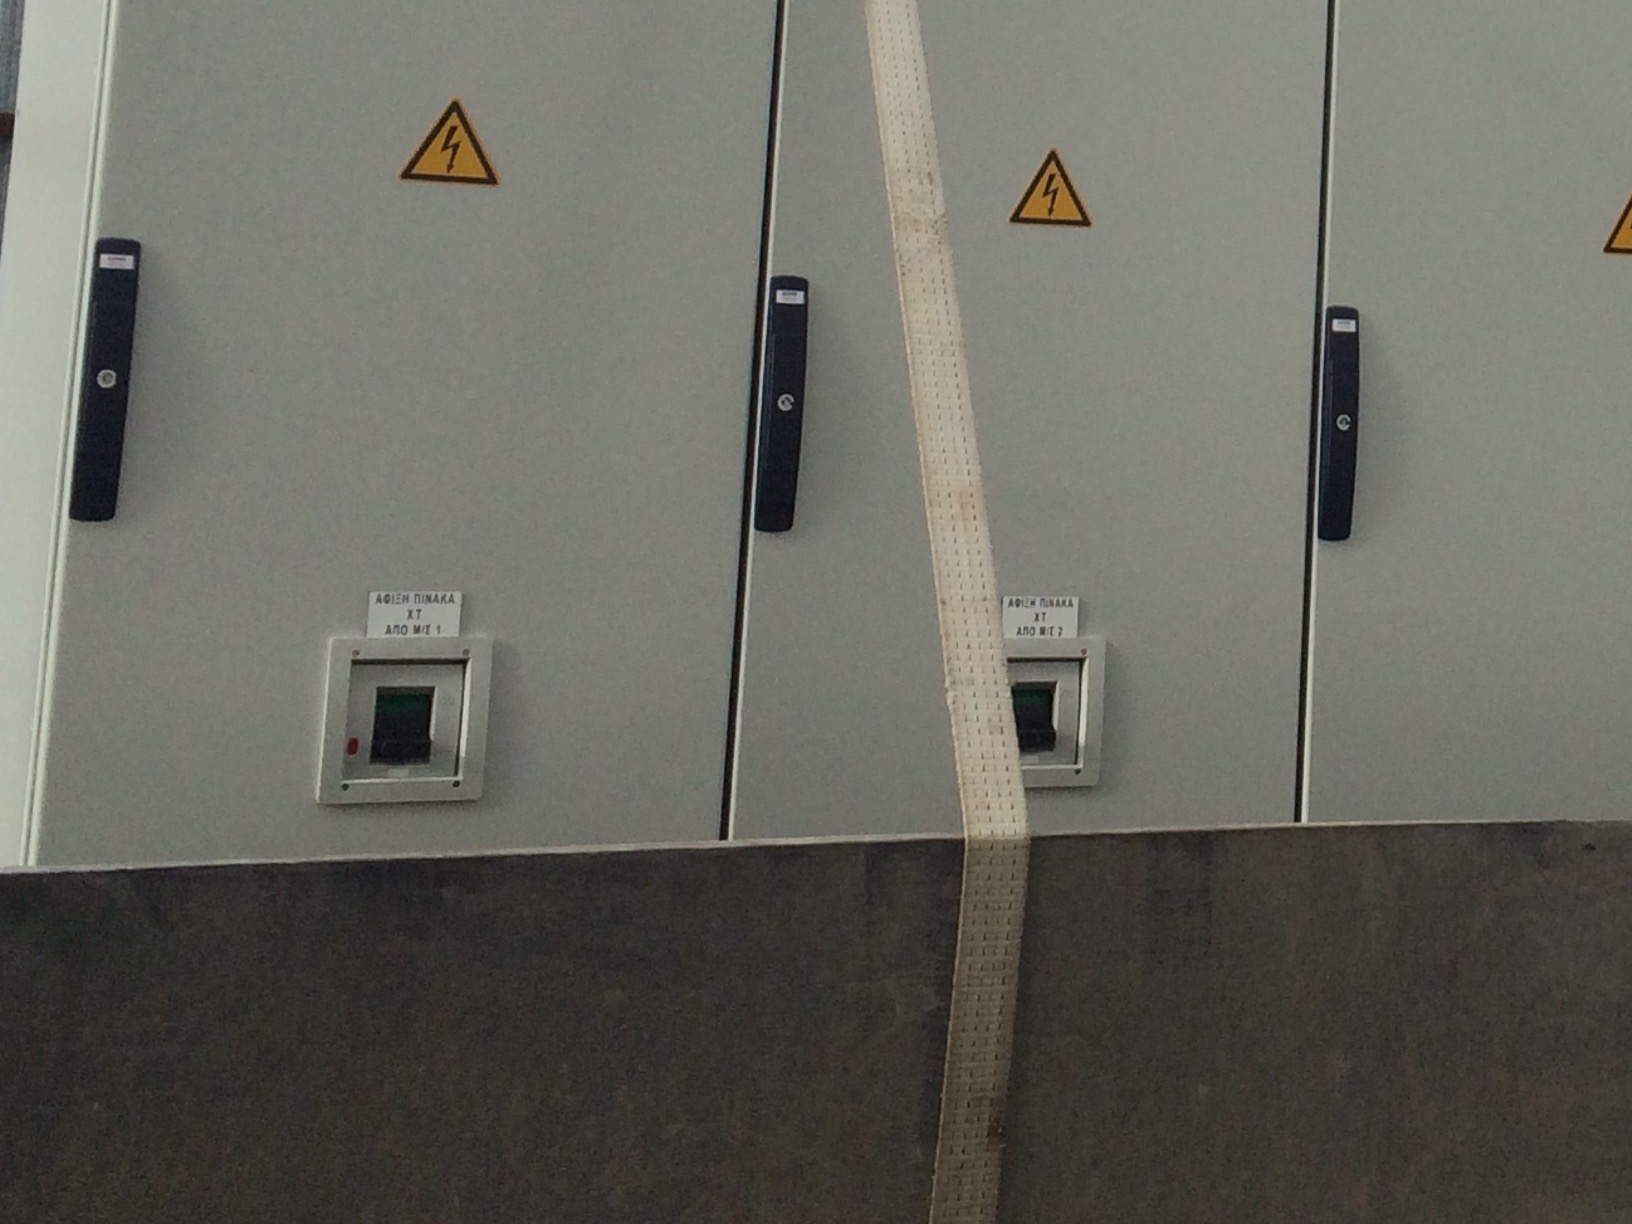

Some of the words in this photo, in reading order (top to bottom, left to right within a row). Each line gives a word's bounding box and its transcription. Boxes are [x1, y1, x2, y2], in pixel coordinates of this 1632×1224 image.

[413, 593, 455, 605] ΠΙΝΑΚΑ
[385, 624, 409, 635] ΑΠΟ
[1016, 626, 1036, 636] ΑΠΟ
